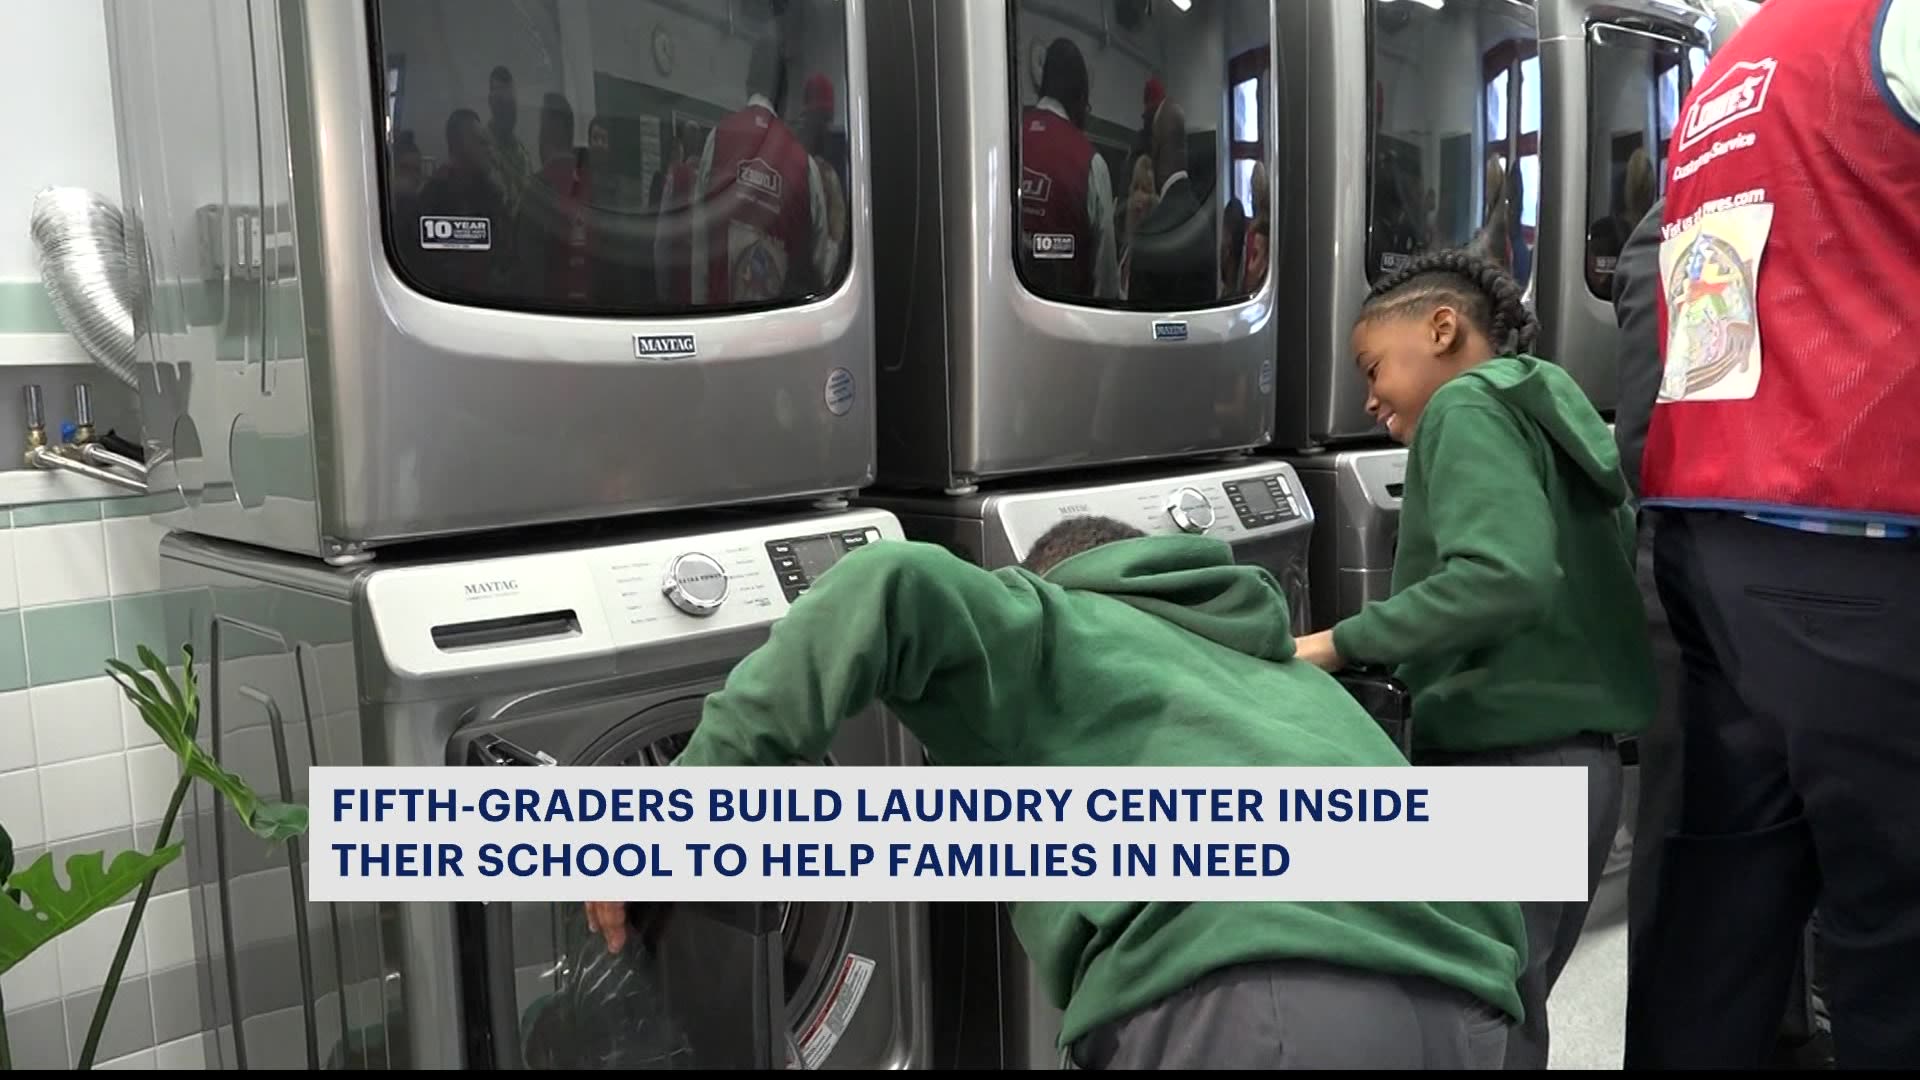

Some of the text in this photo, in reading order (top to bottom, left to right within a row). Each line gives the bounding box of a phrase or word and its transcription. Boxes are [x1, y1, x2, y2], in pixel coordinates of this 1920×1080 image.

[1711, 132, 1756, 158] Service
[424, 220, 486, 239] 10 YEAR
[1036, 237, 1052, 250] 10
[640, 338, 693, 352] MAYTAG
[464, 579, 518, 594] MAYTAG
